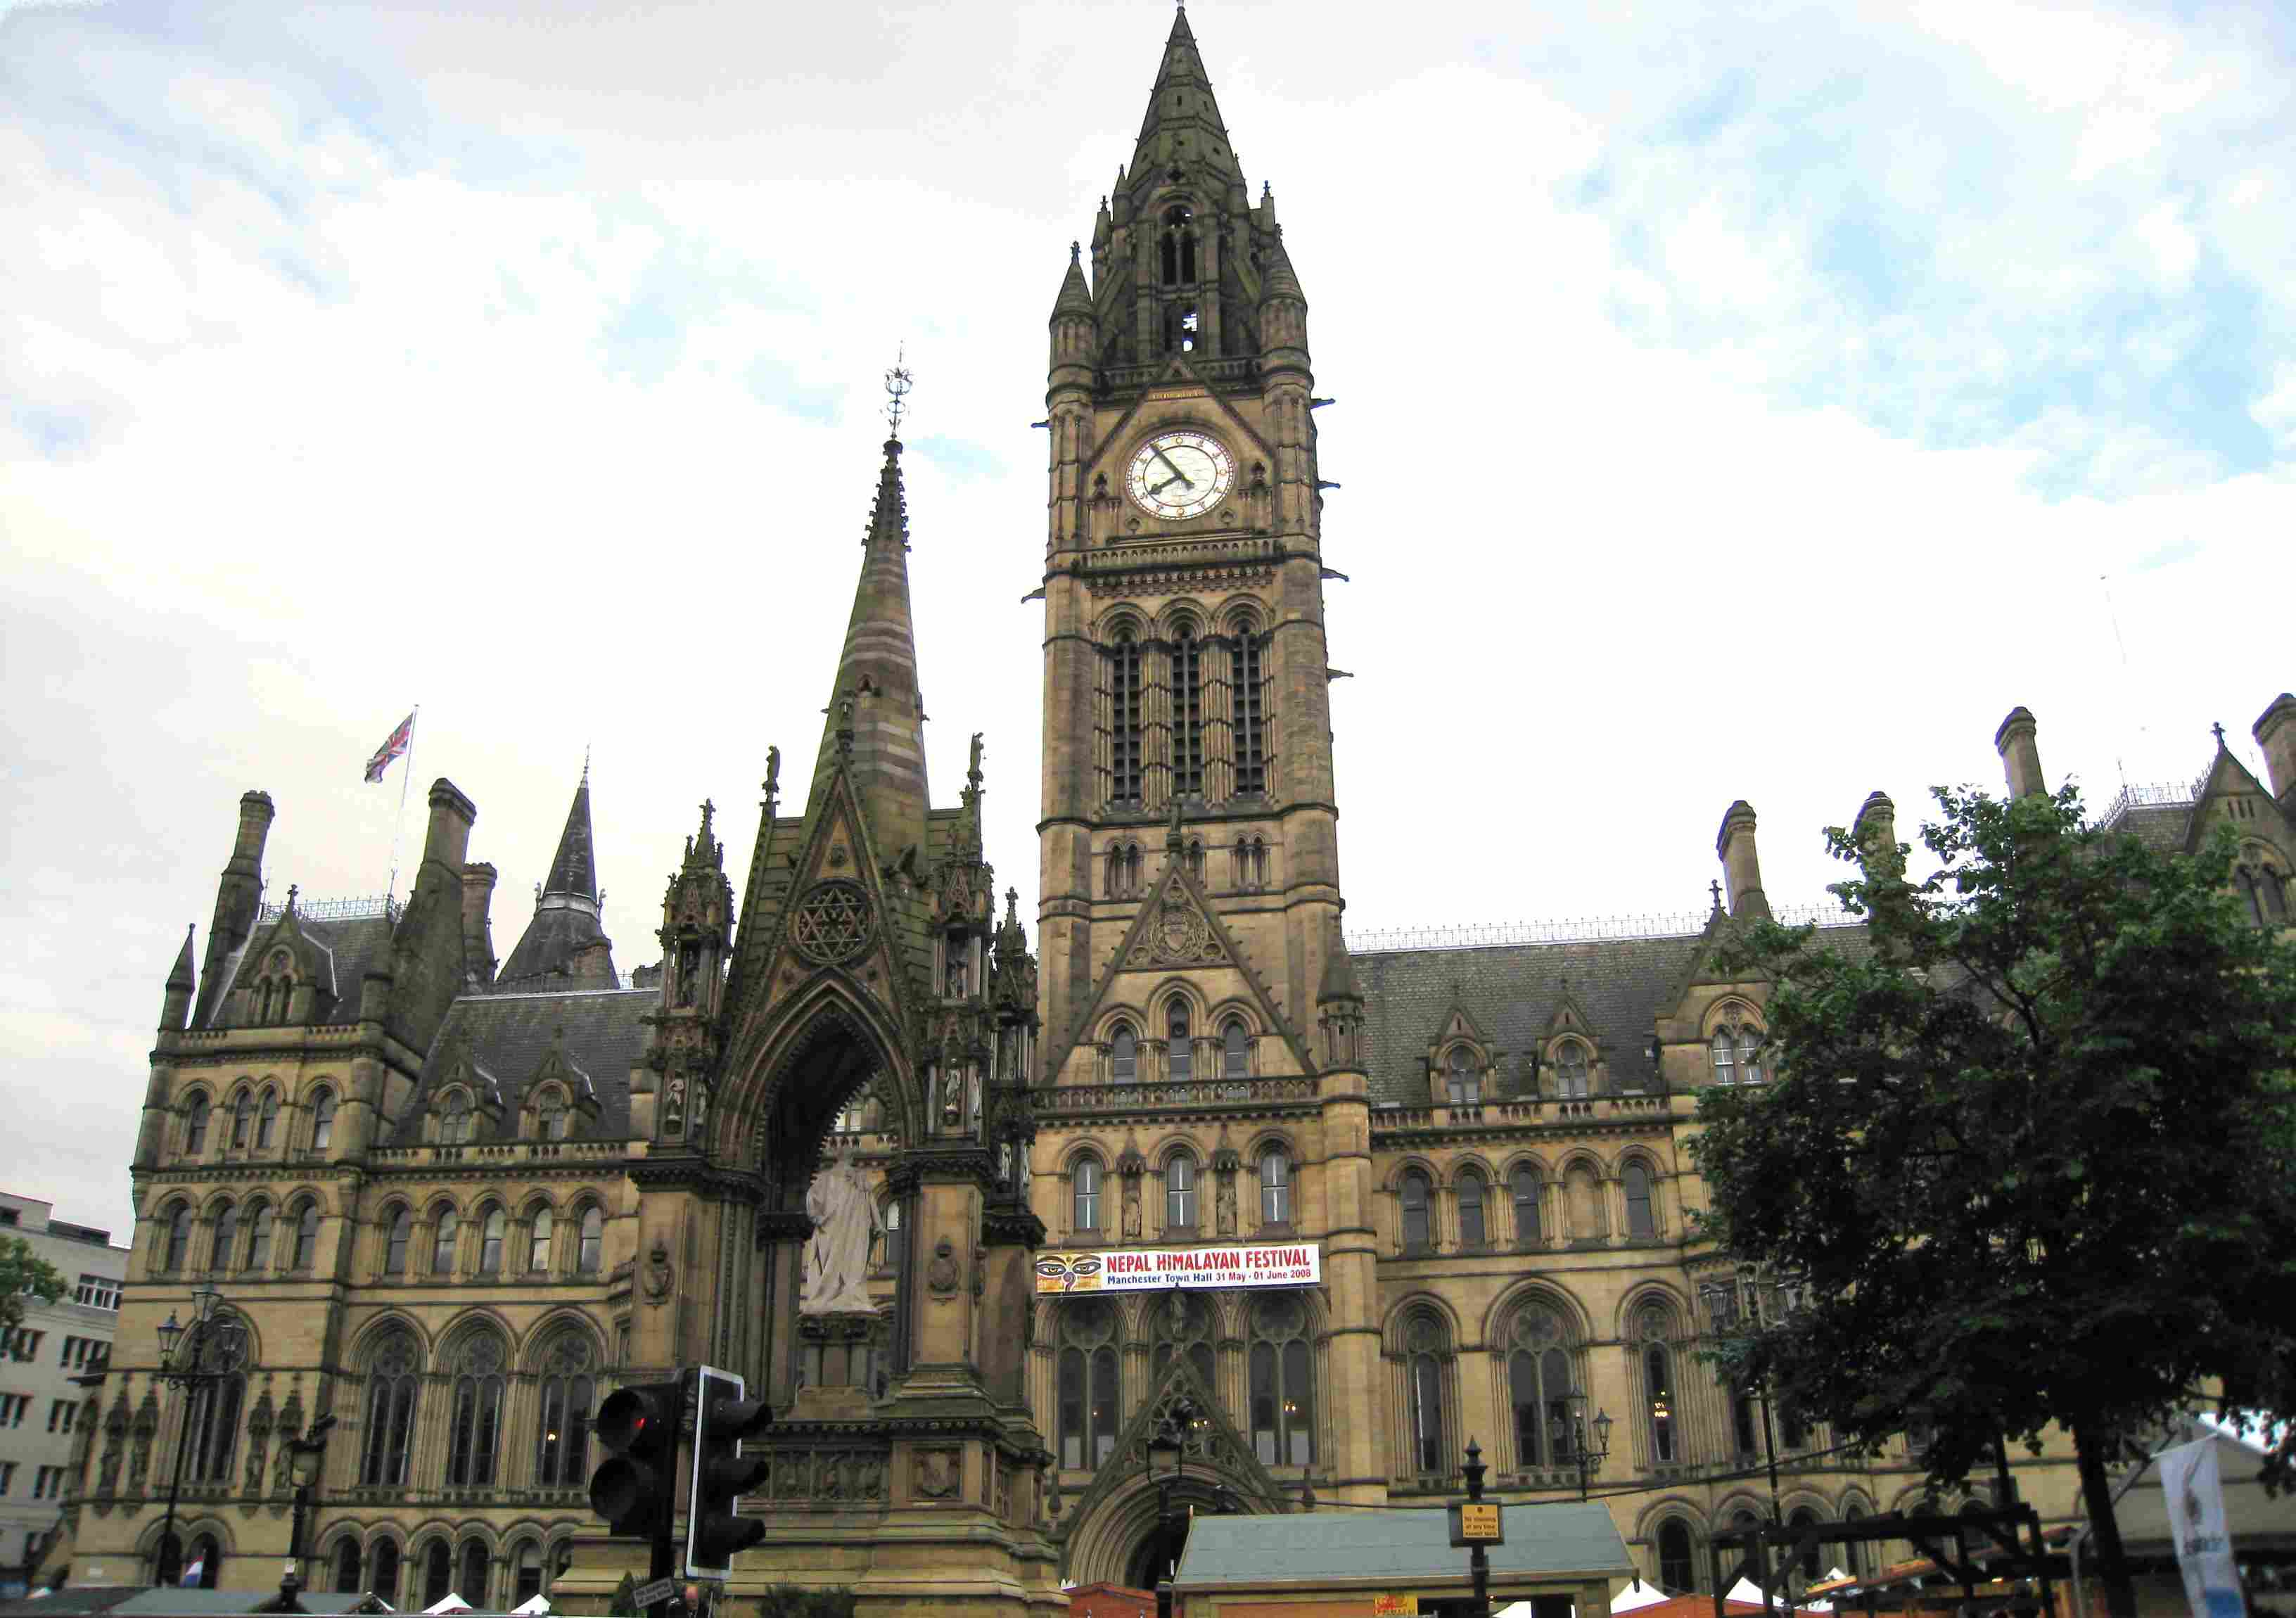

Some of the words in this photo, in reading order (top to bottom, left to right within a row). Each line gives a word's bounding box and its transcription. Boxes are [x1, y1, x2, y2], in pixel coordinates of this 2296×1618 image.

[1106, 1254, 1152, 1273] NEPAL
[1156, 1251, 1240, 1271] HIMALAYAN
[1246, 1249, 1310, 1268] FESTIVAL
[1107, 1274, 1161, 1285] Manchester
[1165, 1273, 1190, 1283] Town
[1193, 1273, 1212, 1282] Hall
[1216, 1272, 1225, 1281] 31
[1229, 1271, 1246, 1282] May
[1254, 1270, 1264, 1280] 01
[1267, 1270, 1288, 1280] June
[1290, 1268, 1311, 1278] 2008
